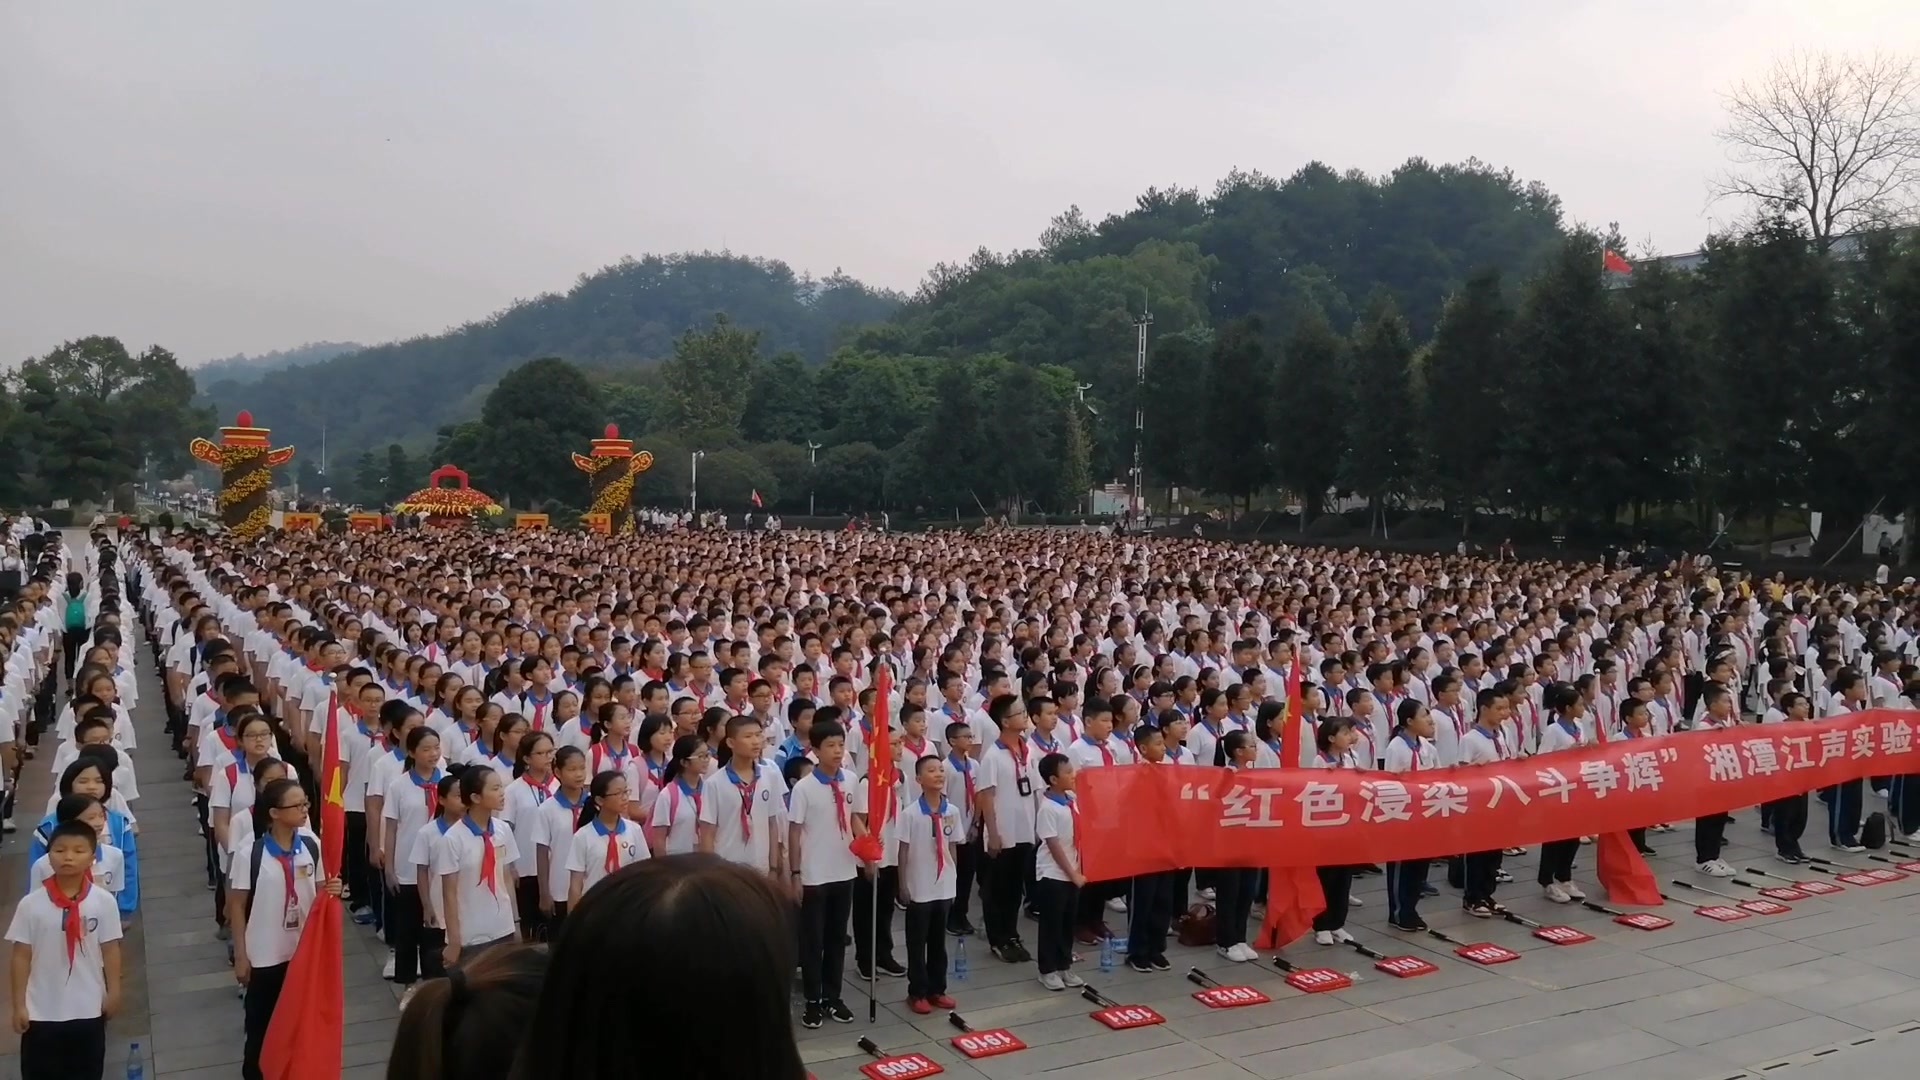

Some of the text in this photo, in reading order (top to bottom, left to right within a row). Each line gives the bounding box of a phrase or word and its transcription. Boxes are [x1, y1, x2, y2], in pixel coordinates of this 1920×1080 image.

[1703, 719, 1920, 782] 湘潭江声实验
[1466, 946, 1508, 960] 1915
[1382, 958, 1424, 972] 1914
[1295, 970, 1338, 984] 1913
[1210, 987, 1258, 1001] 1912
[1104, 1008, 1152, 1023] 1911
[960, 1032, 1011, 1050] 1910
[876, 1056, 928, 1076] 1909
